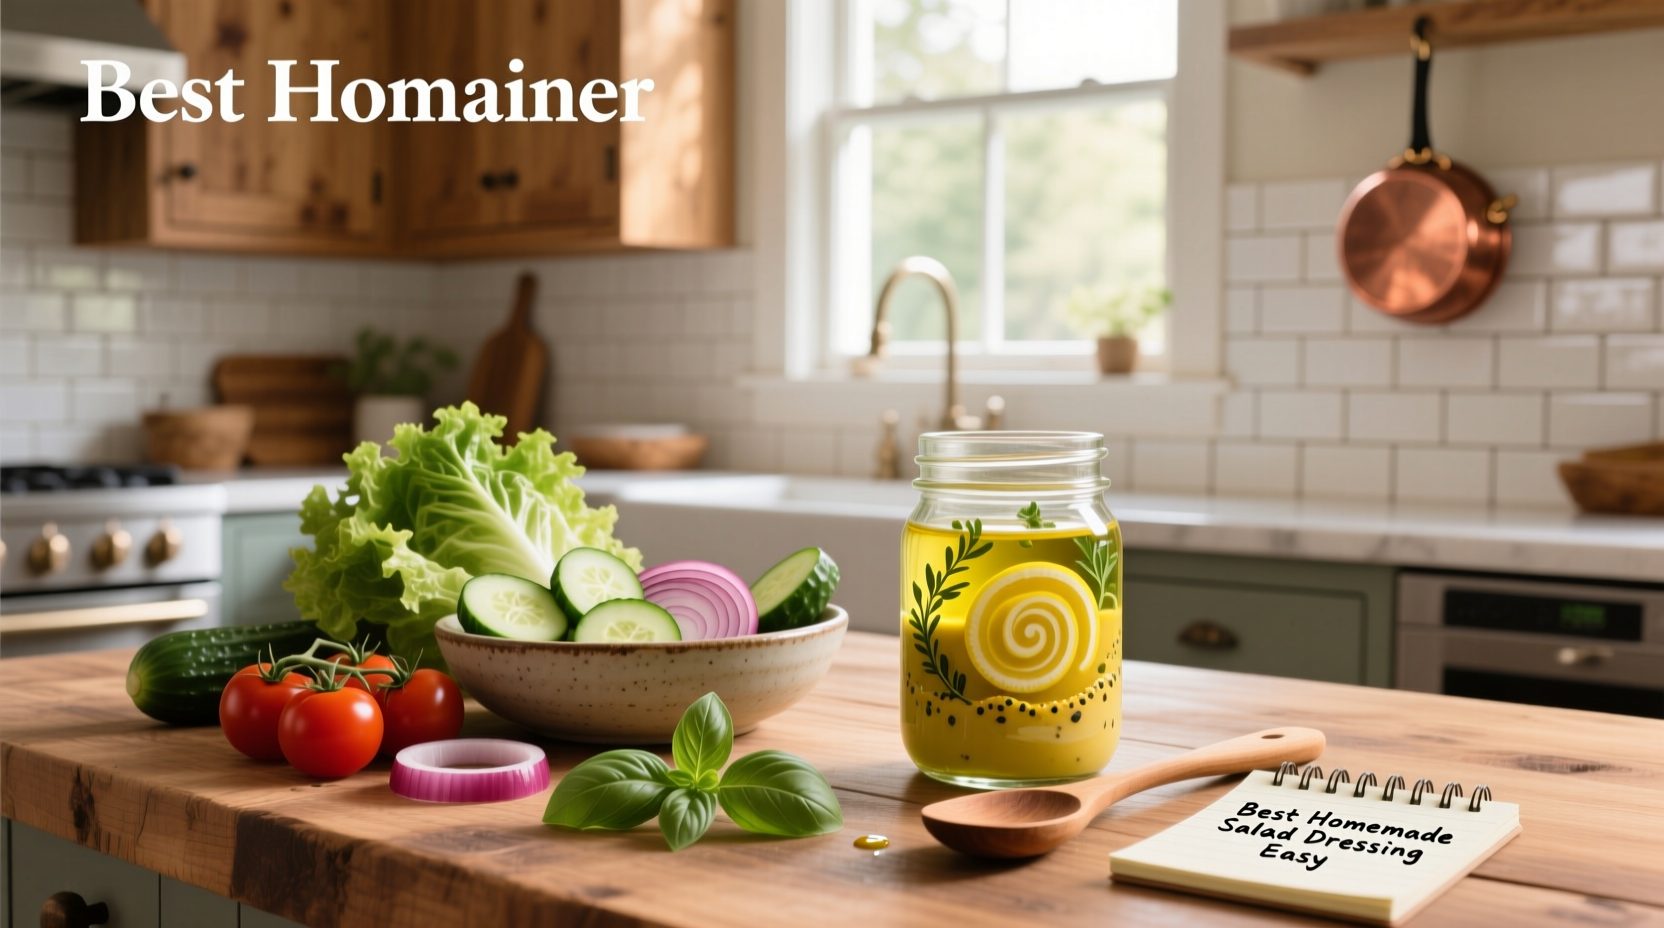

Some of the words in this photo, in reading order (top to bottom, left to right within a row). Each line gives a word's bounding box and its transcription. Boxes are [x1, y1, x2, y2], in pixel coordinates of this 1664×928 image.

[1217, 817, 1299, 842] Salad
[1303, 829, 1424, 866] Dressing
[1236, 801, 1300, 822] Best
[1306, 810, 1454, 846] Homemade
[1259, 843, 1329, 872] Easy
